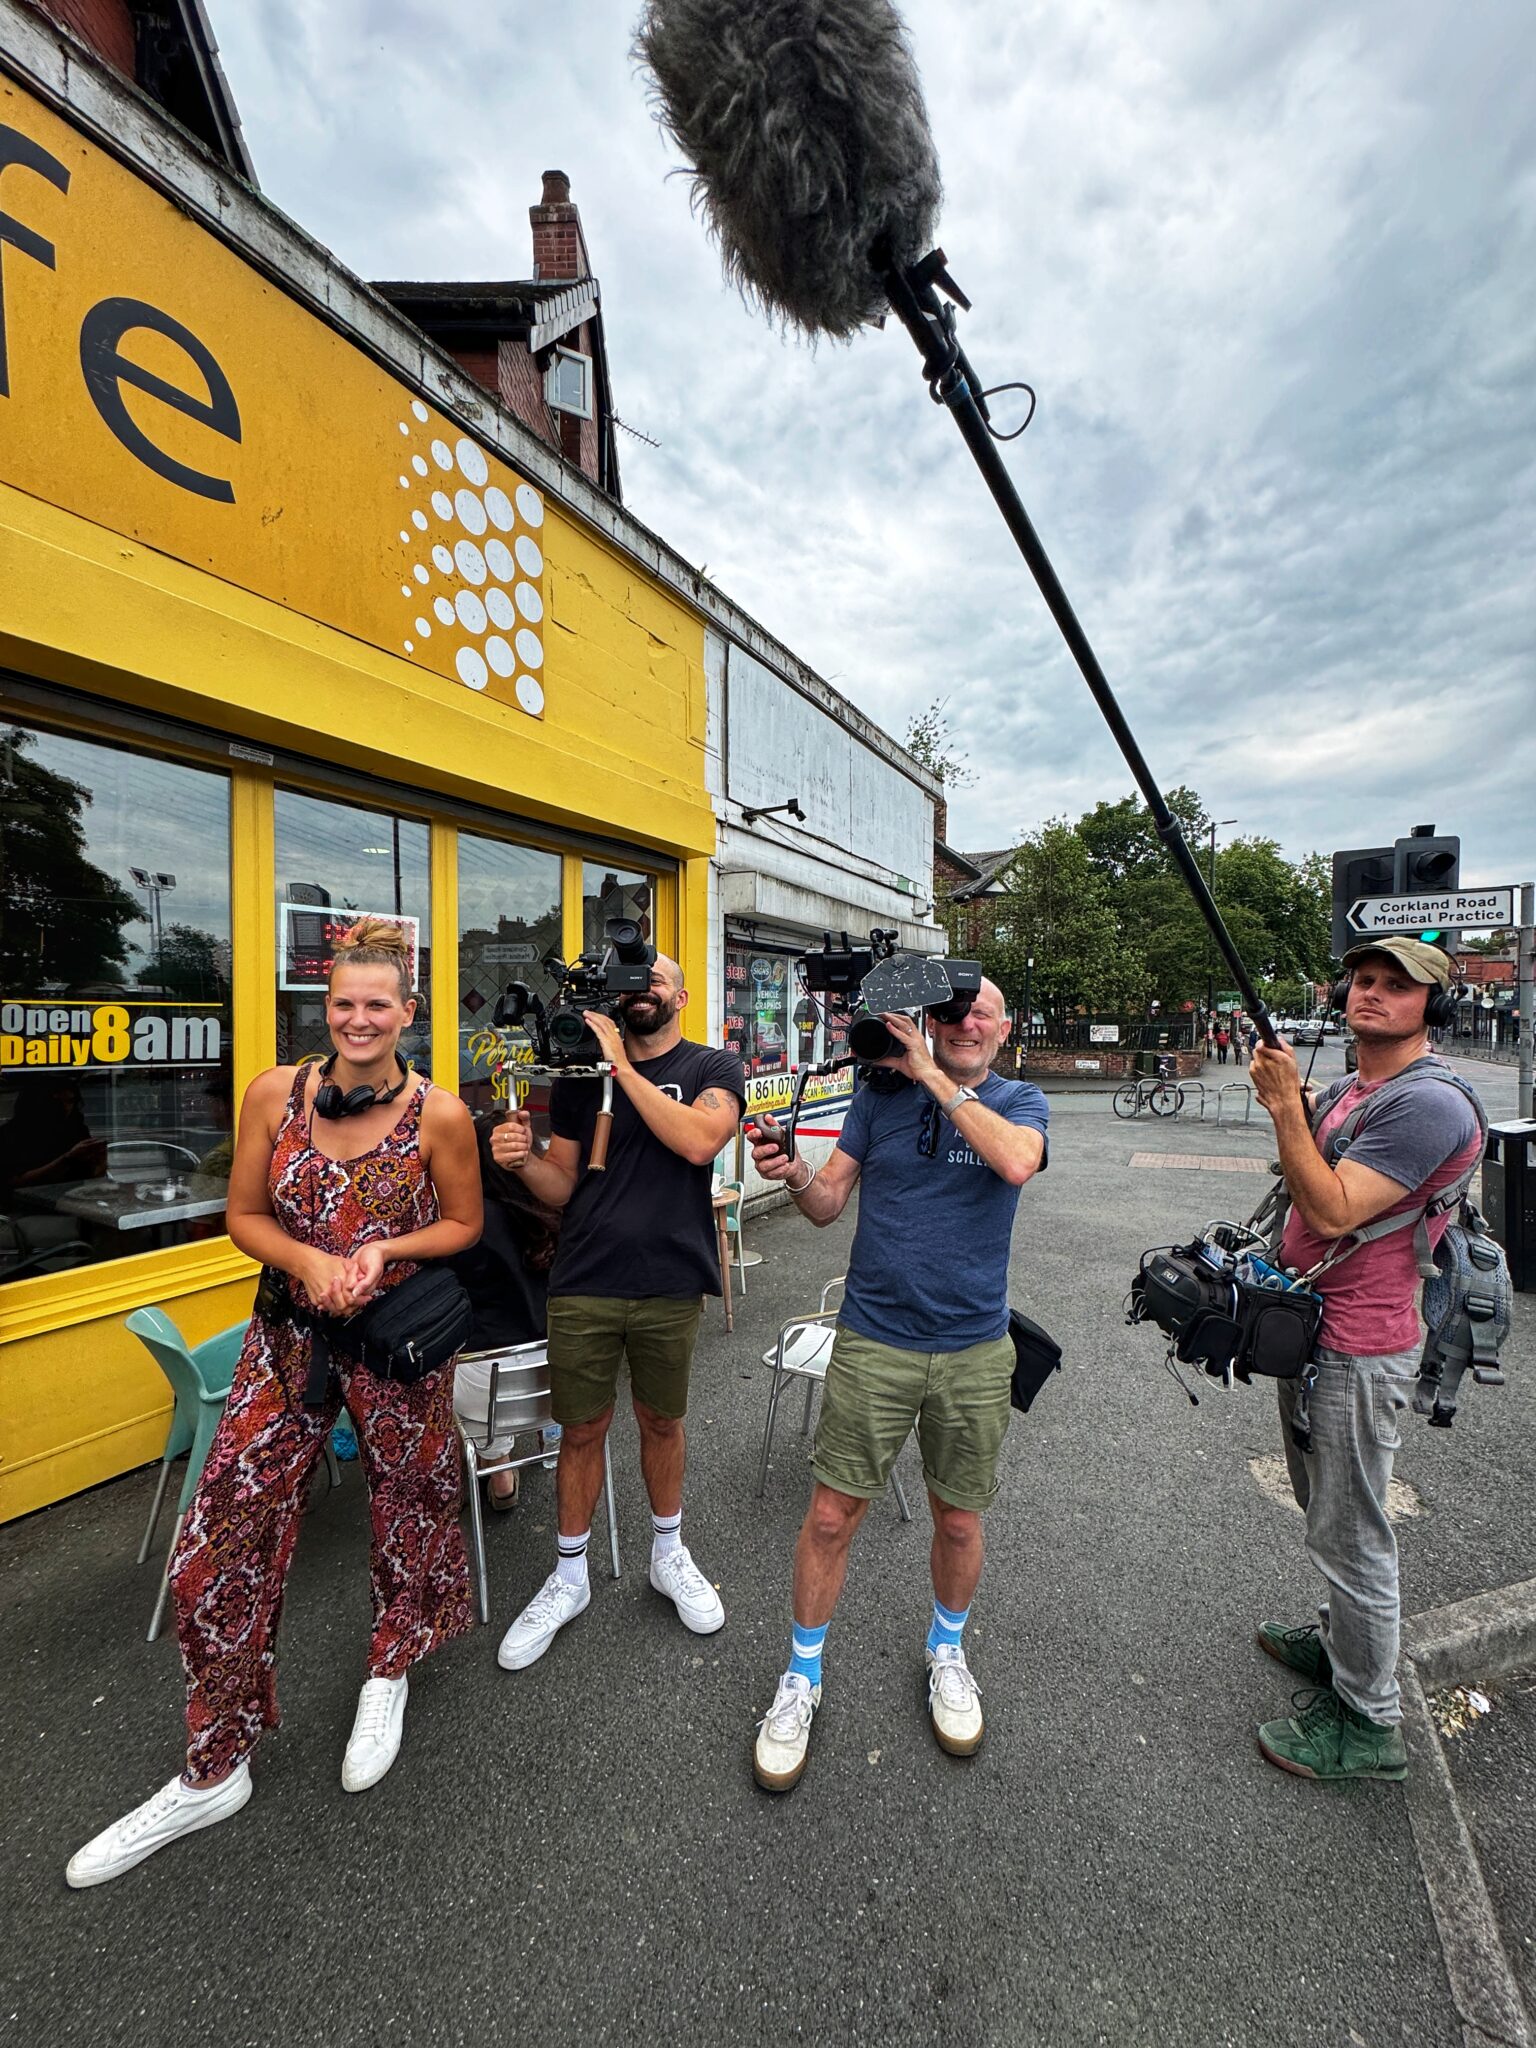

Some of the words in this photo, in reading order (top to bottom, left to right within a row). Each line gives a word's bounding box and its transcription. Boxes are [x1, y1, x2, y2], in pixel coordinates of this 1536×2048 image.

[1380, 899, 1450, 913] Corkland
[1456, 896, 1497, 909] Road
[1374, 913, 1432, 926] Medical
[1438, 909, 1504, 923] Practice
[757, 990, 779, 999] VEHICLE
[755, 1001, 782, 1010] GRAPHICS
[1, 1003, 91, 1036] Open
[91, 1005, 221, 1063] 8am
[0, 1034, 91, 1066] Daily
[755, 1078, 774, 1100] 861
[821, 1084, 834, 1096] PRINT
[947, 1149, 988, 1167] SCILL
